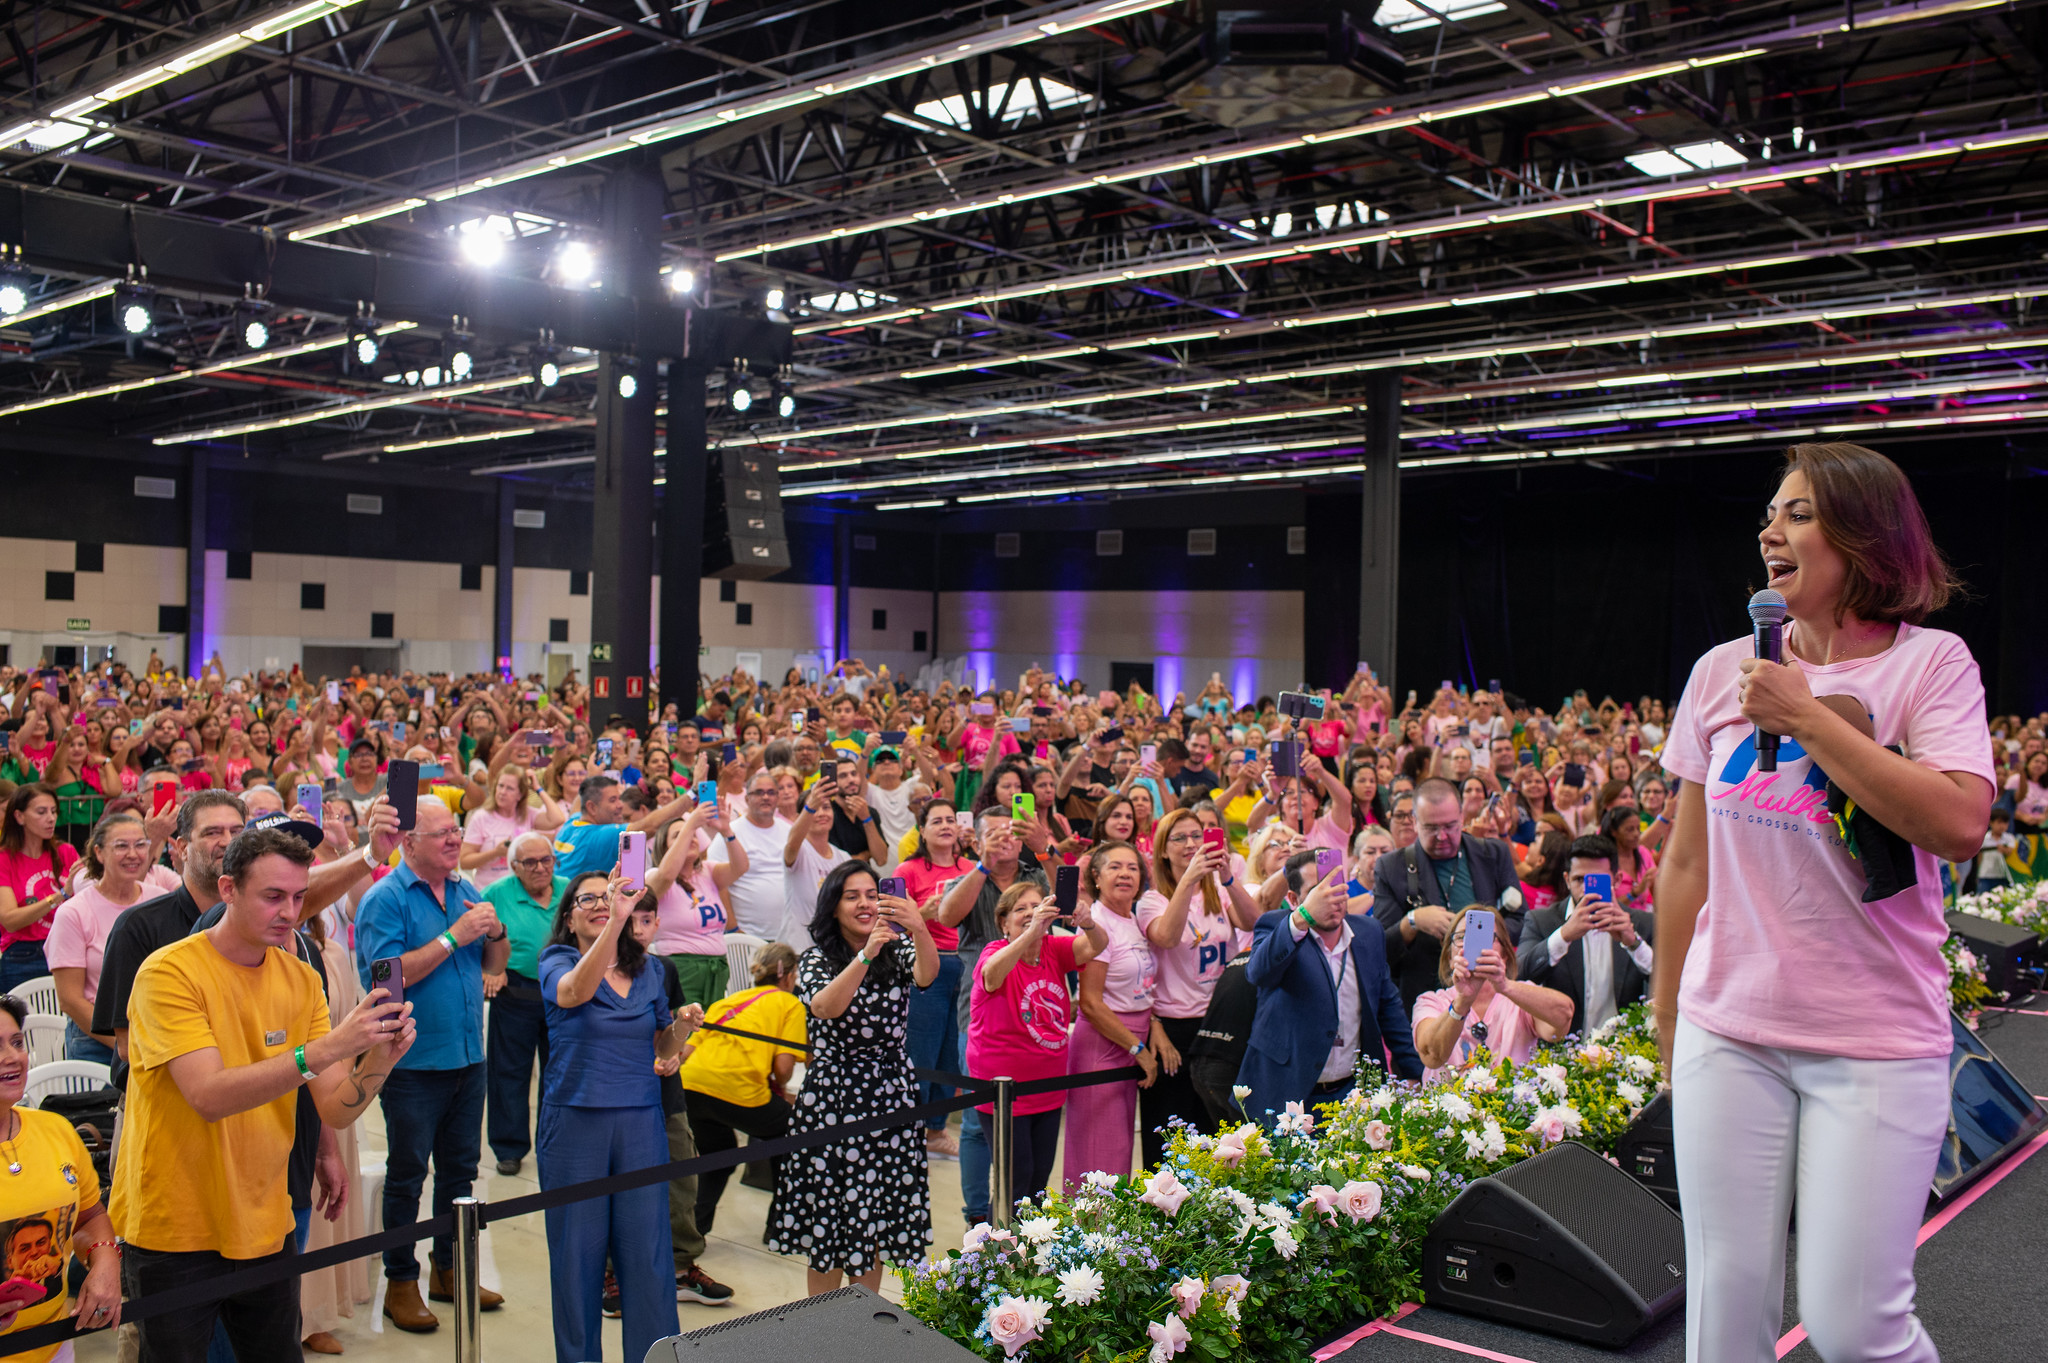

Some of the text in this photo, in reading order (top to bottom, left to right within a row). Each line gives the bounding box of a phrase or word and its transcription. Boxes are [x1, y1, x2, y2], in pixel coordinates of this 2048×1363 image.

[1710, 770, 1836, 824] Mulhe
[1711, 807, 1740, 820] MATO
[1748, 815, 1799, 832] GROSSO
[1807, 828, 1821, 840] DO
[698, 903, 726, 928] PL
